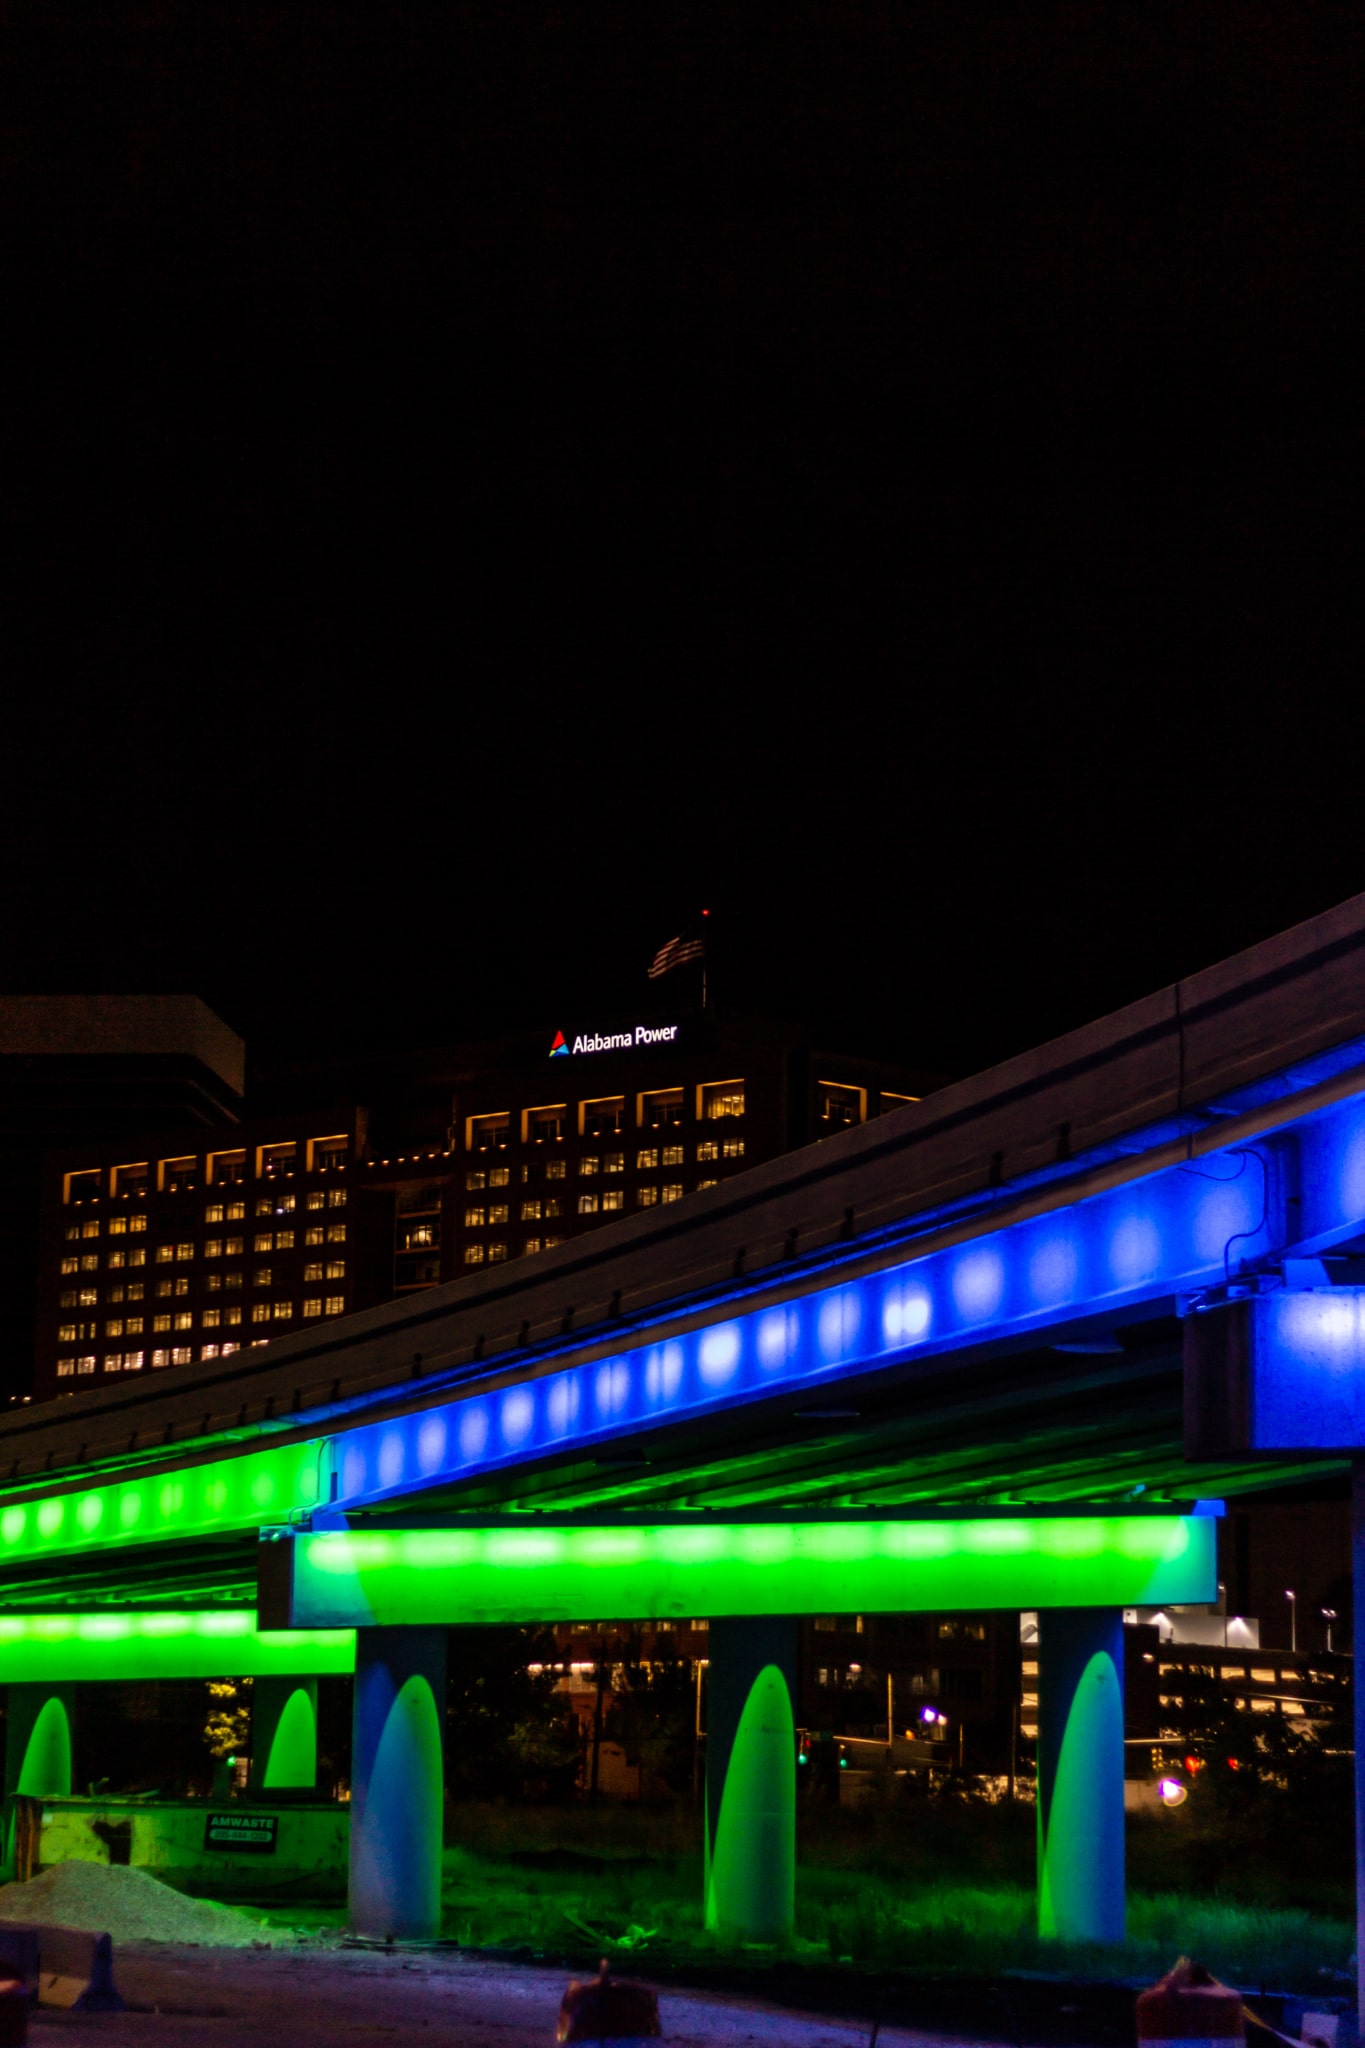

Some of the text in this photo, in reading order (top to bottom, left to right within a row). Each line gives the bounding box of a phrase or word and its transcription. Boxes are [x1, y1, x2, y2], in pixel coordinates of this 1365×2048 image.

[572, 1026, 678, 1055] Alabama Power
[210, 1816, 274, 1829] AMWASTE
